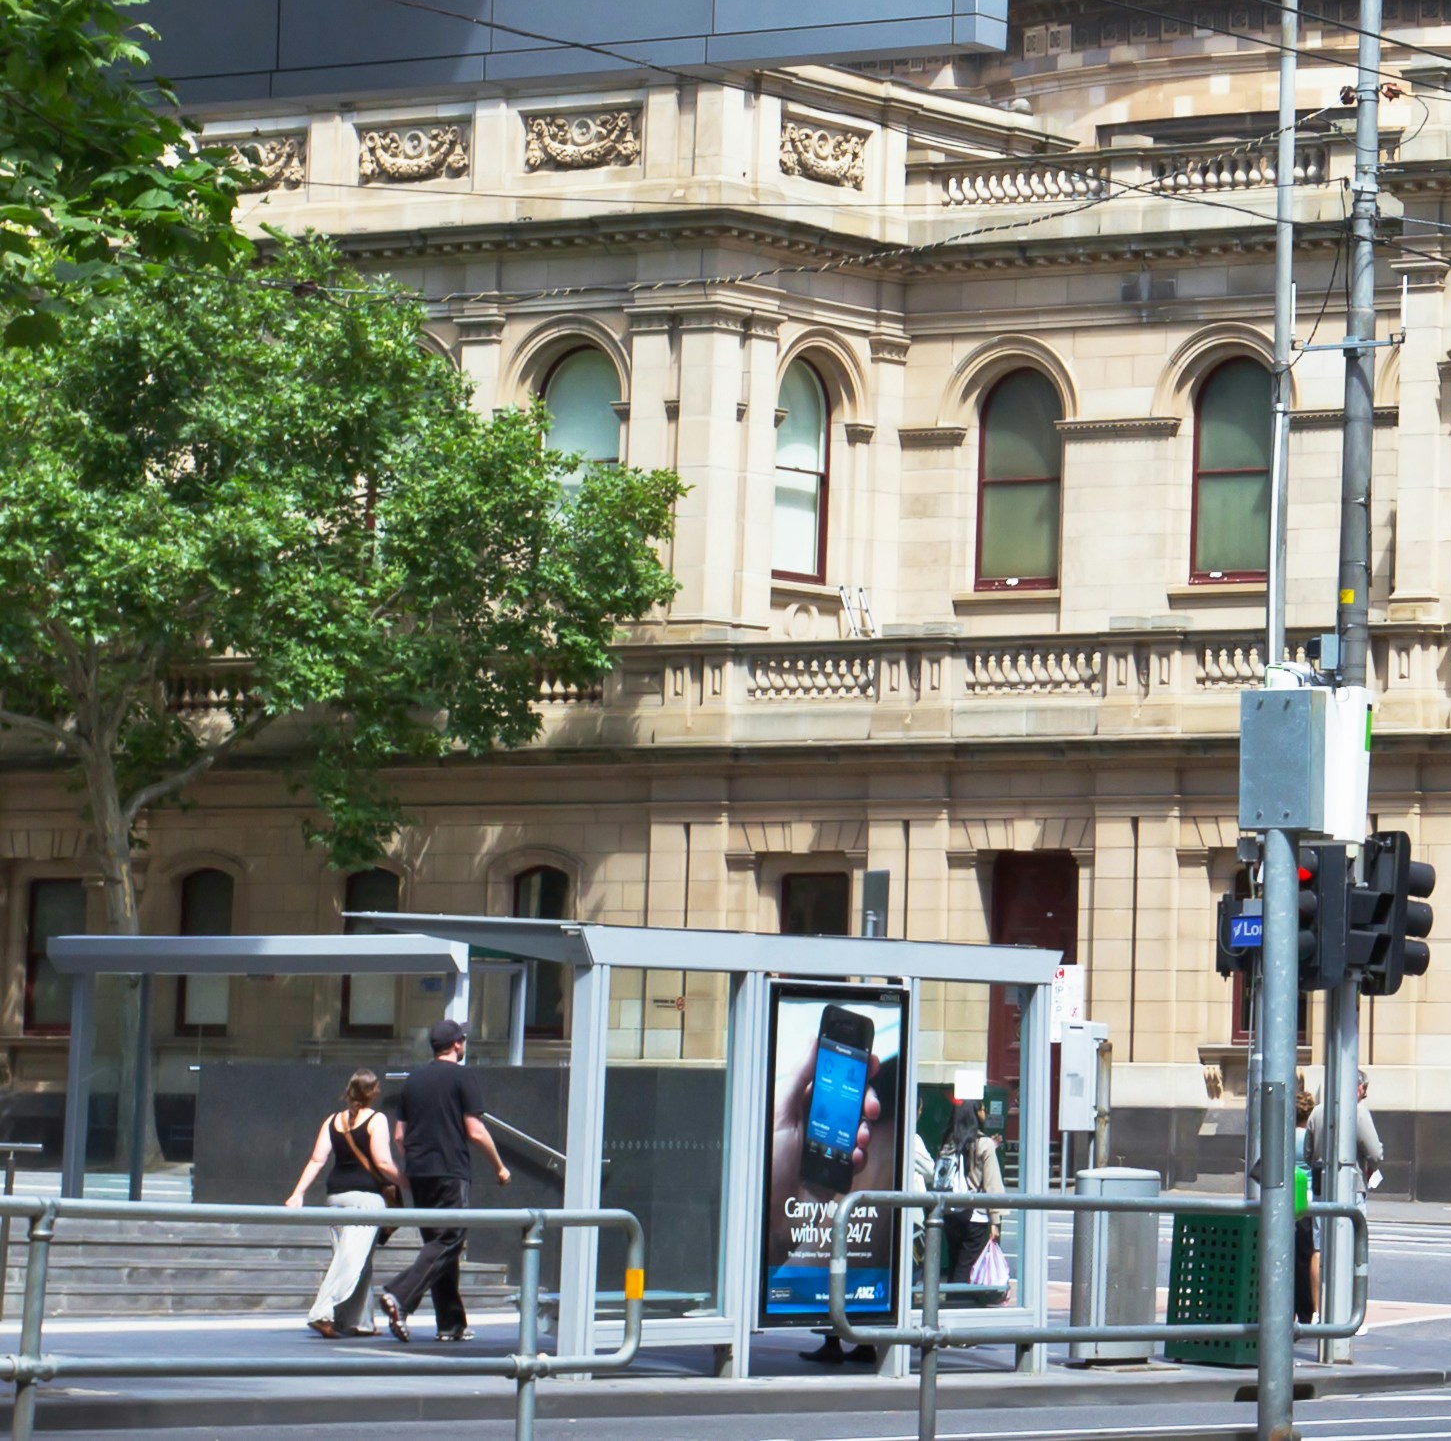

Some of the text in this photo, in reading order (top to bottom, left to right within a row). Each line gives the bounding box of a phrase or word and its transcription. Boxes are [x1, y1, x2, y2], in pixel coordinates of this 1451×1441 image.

[785, 1196, 819, 1223] Carry
[790, 1222, 819, 1243] with
[819, 1226, 832, 1248] yo
[855, 1286, 875, 1300] ANZ
